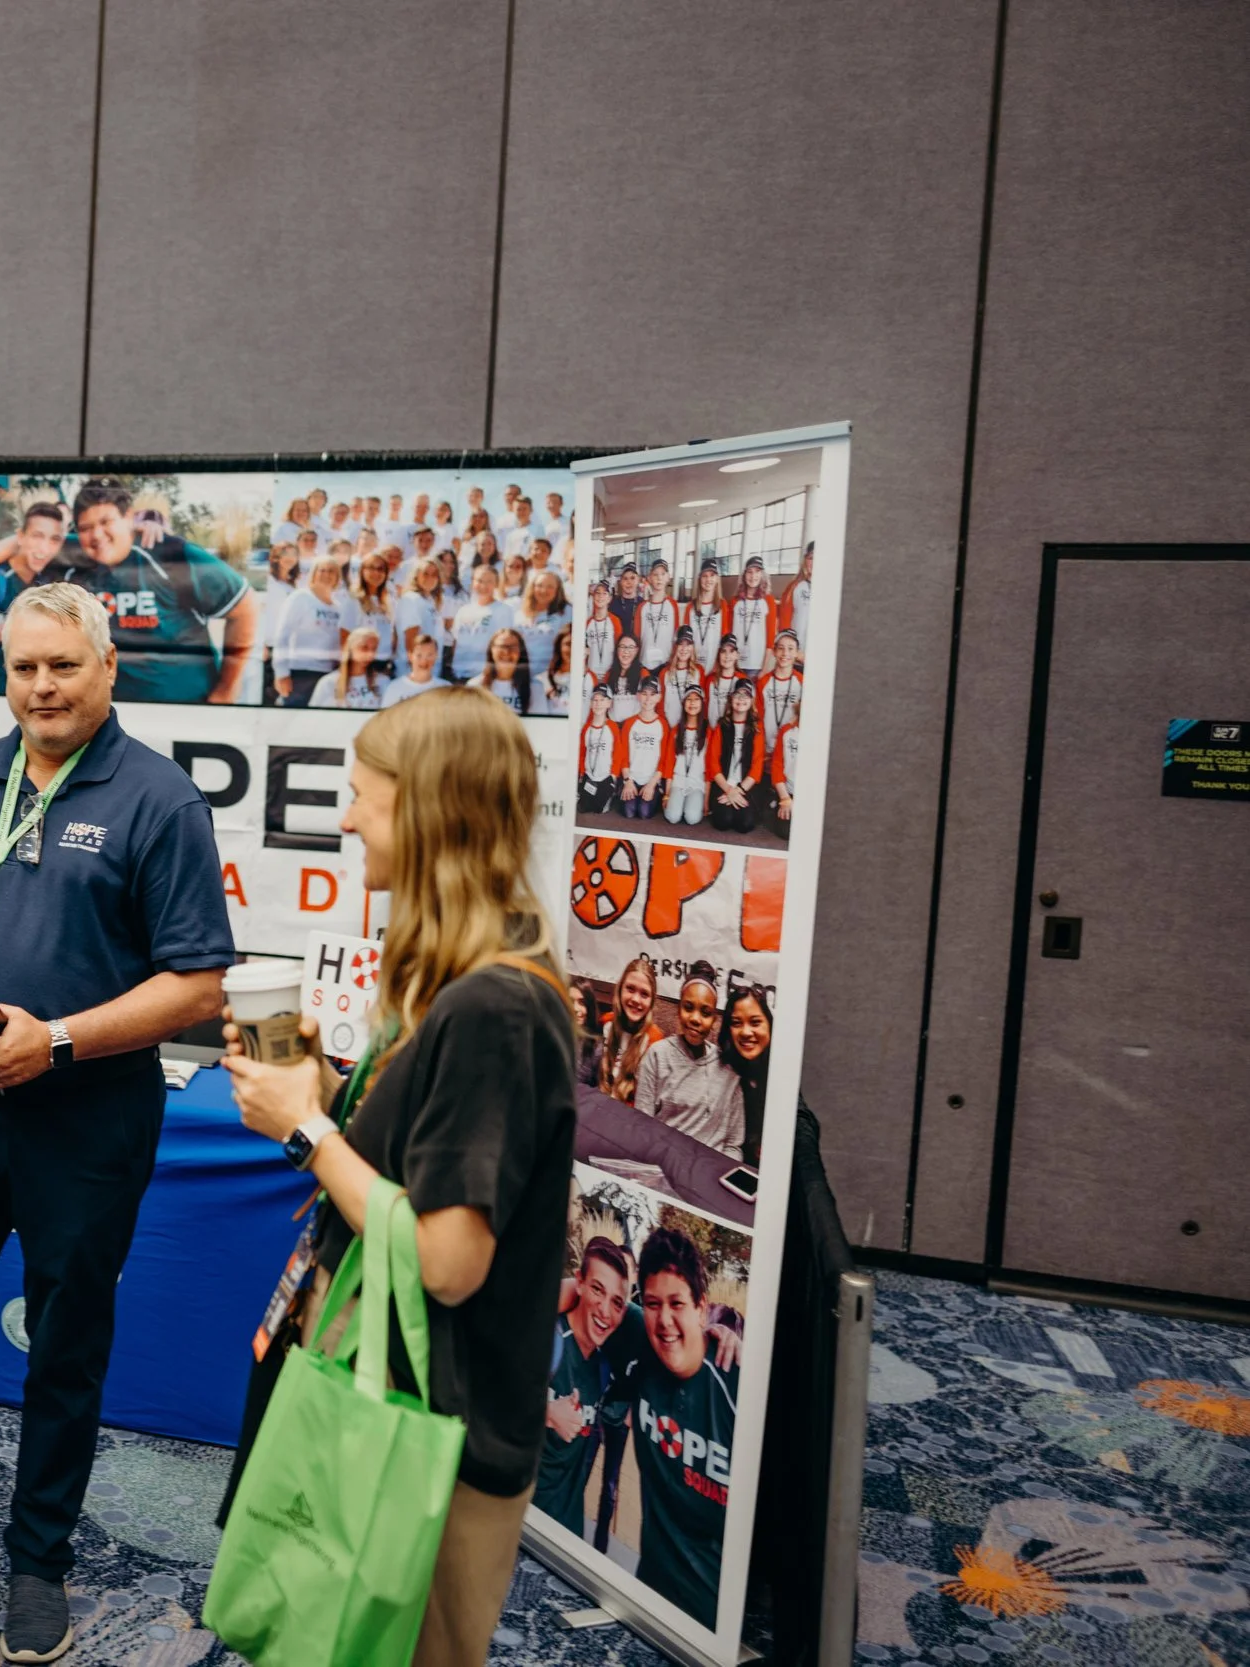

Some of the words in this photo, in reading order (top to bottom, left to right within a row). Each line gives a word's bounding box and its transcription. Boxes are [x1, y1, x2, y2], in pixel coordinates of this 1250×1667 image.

[95, 591, 158, 617] OPE
[118, 615, 160, 628] SQUAD
[1174, 748, 1204, 756] THESE
[1206, 749, 1243, 757] DOORS
[1174, 755, 1213, 764] REMAIN
[1196, 763, 1216, 771] ALL
[1218, 764, 1248, 773] TIMES
[1192, 780, 1227, 789] THANK
[64, 821, 109, 839] HOPE
[61, 834, 103, 846] SQUAD
[639, 1398, 730, 1486] HOPE
